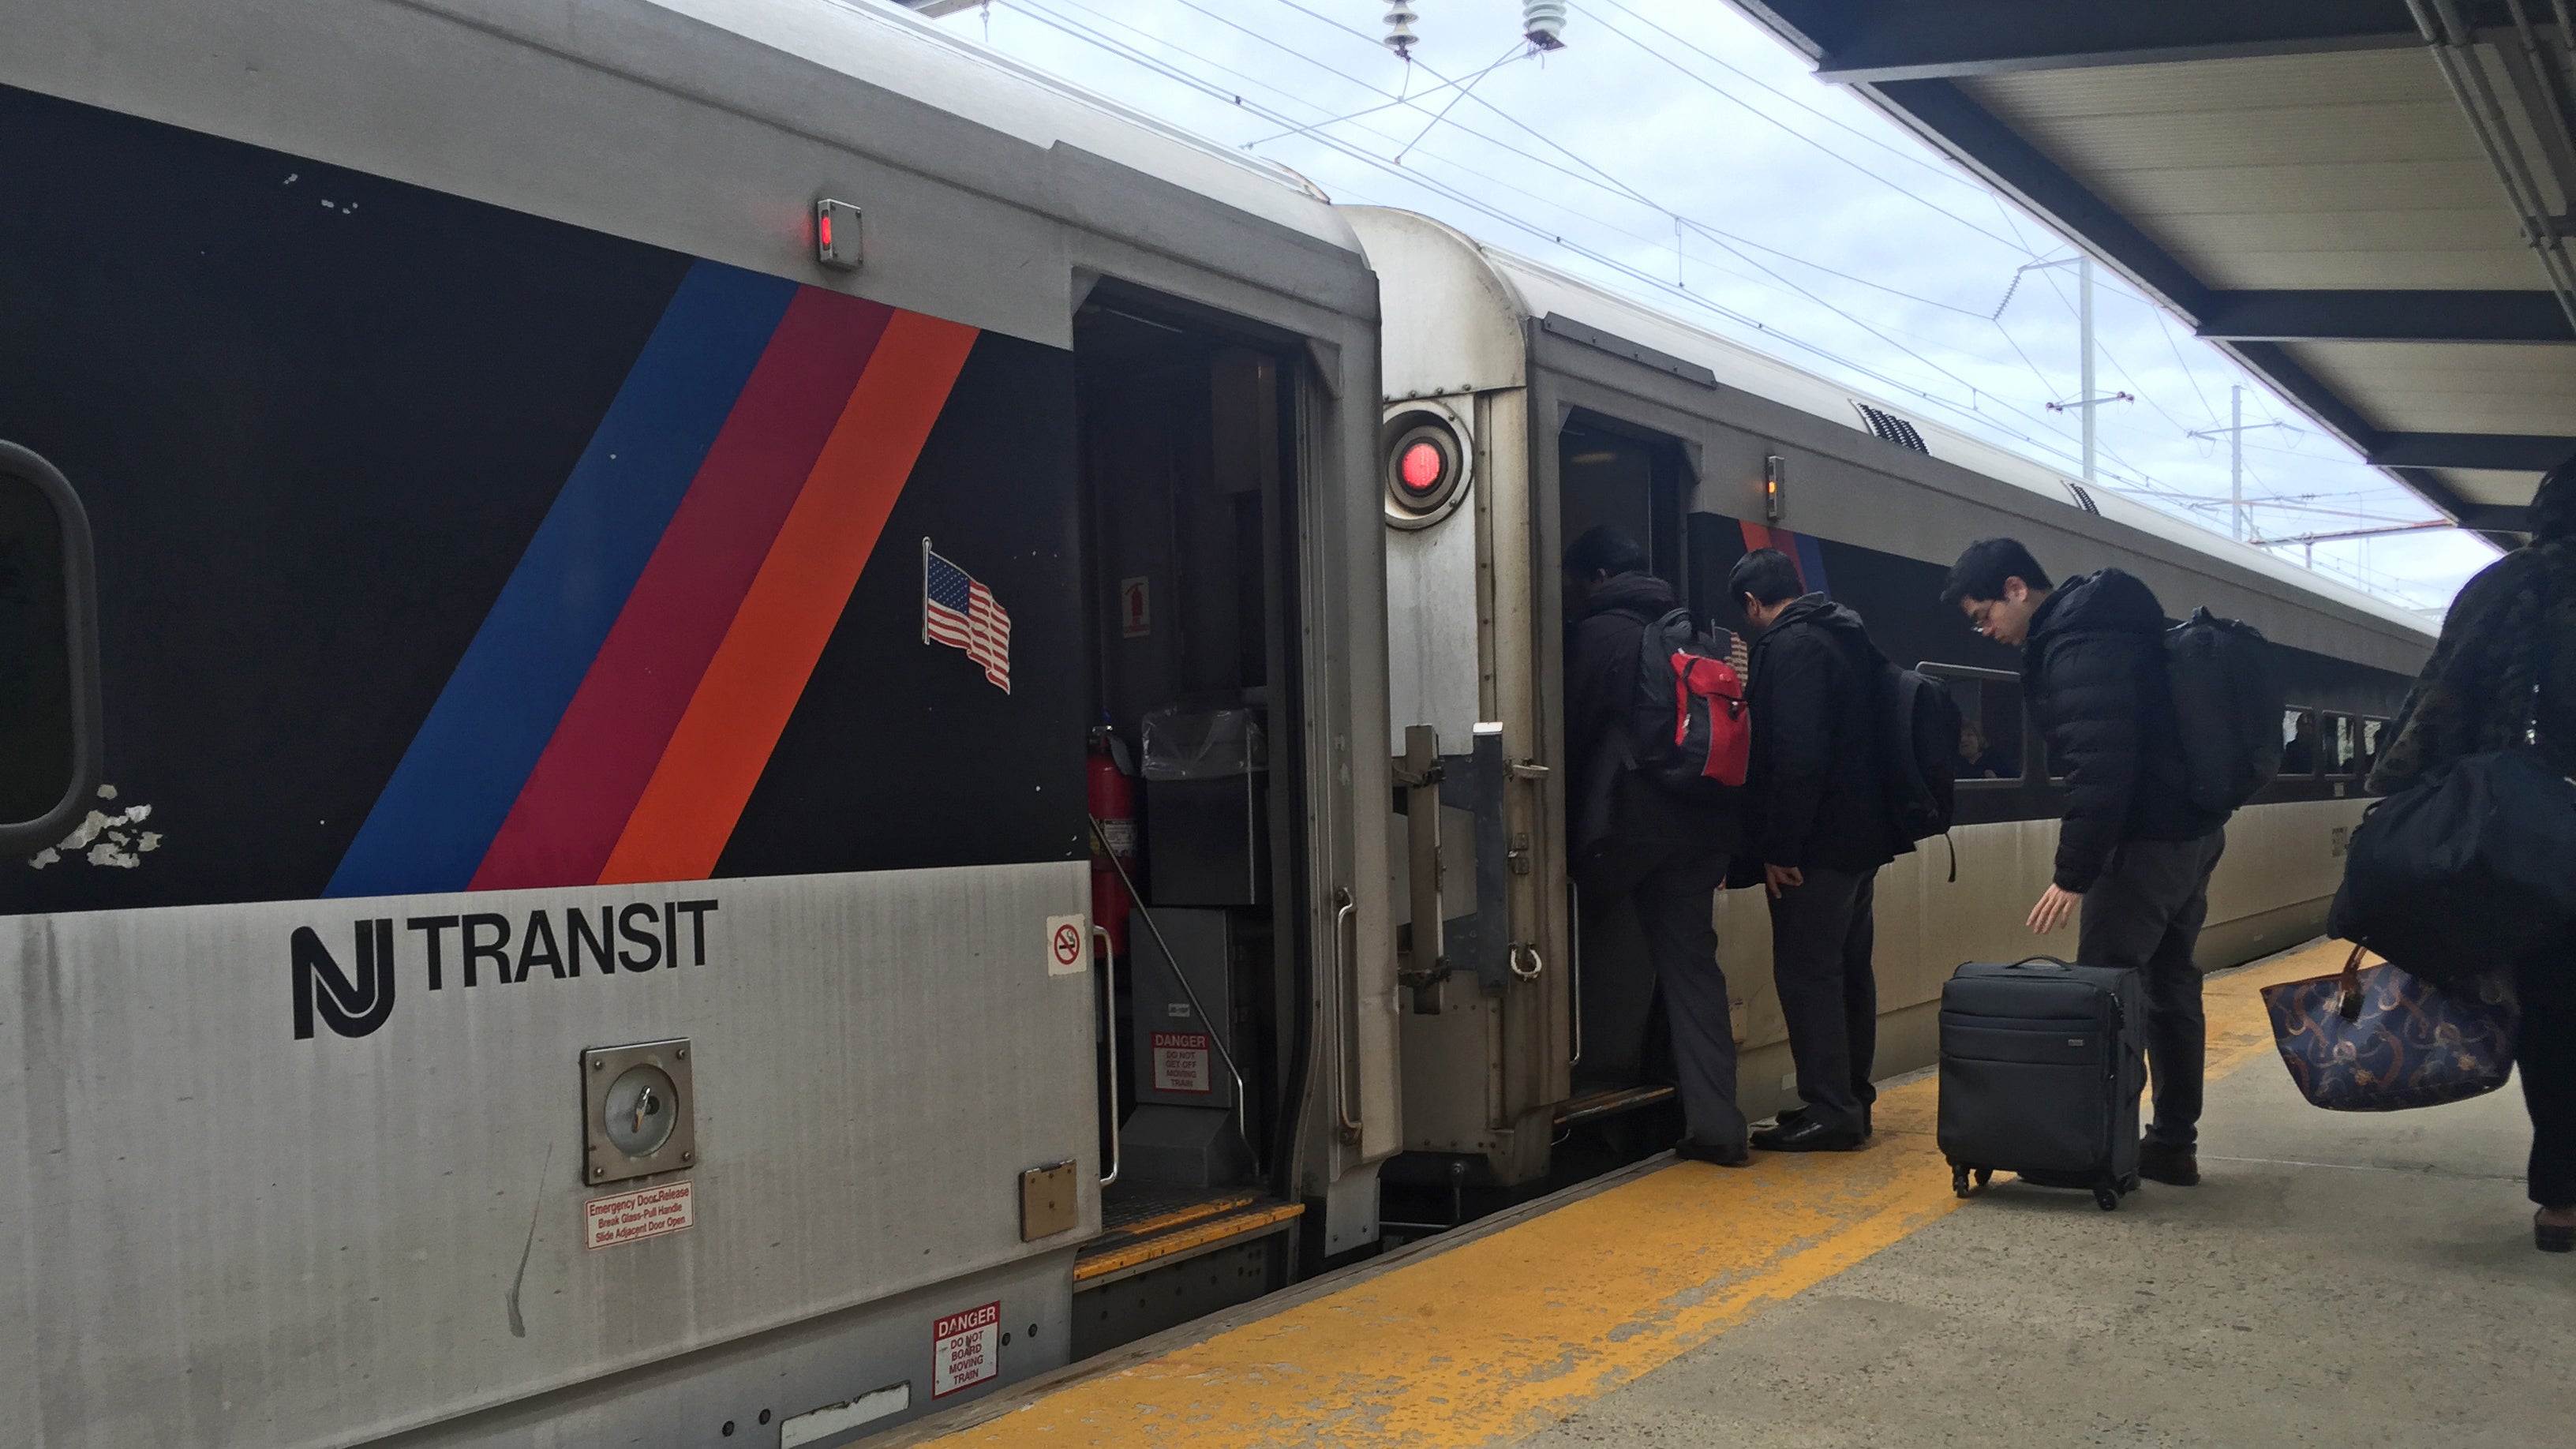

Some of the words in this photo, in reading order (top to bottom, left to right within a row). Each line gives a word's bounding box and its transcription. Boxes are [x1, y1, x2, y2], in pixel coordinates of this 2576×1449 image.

[290, 918, 395, 1040] NJ
[406, 898, 719, 991] TRANSIT
[1155, 1034, 1206, 1048] DANGER
[1166, 1050, 1178, 1059] DO
[1166, 1069, 1197, 1078] MOVING
[590, 1198, 635, 1216] Emergency
[637, 1195, 657, 1207] Door
[658, 1188, 689, 1200] Release
[598, 1216, 620, 1229] Break
[658, 1203, 683, 1215] Handle
[595, 1232, 614, 1243] Slide
[616, 1223, 647, 1239] Adjacent
[648, 1220, 665, 1231] Door
[667, 1216, 686, 1228] Open
[938, 1305, 996, 1338] DANGER
[950, 1337, 964, 1350] DO
[965, 1331, 984, 1345] NOT
[951, 1343, 983, 1362] BOARD
[949, 1354, 984, 1375] MOVING
[953, 1368, 979, 1385] TRAIN
